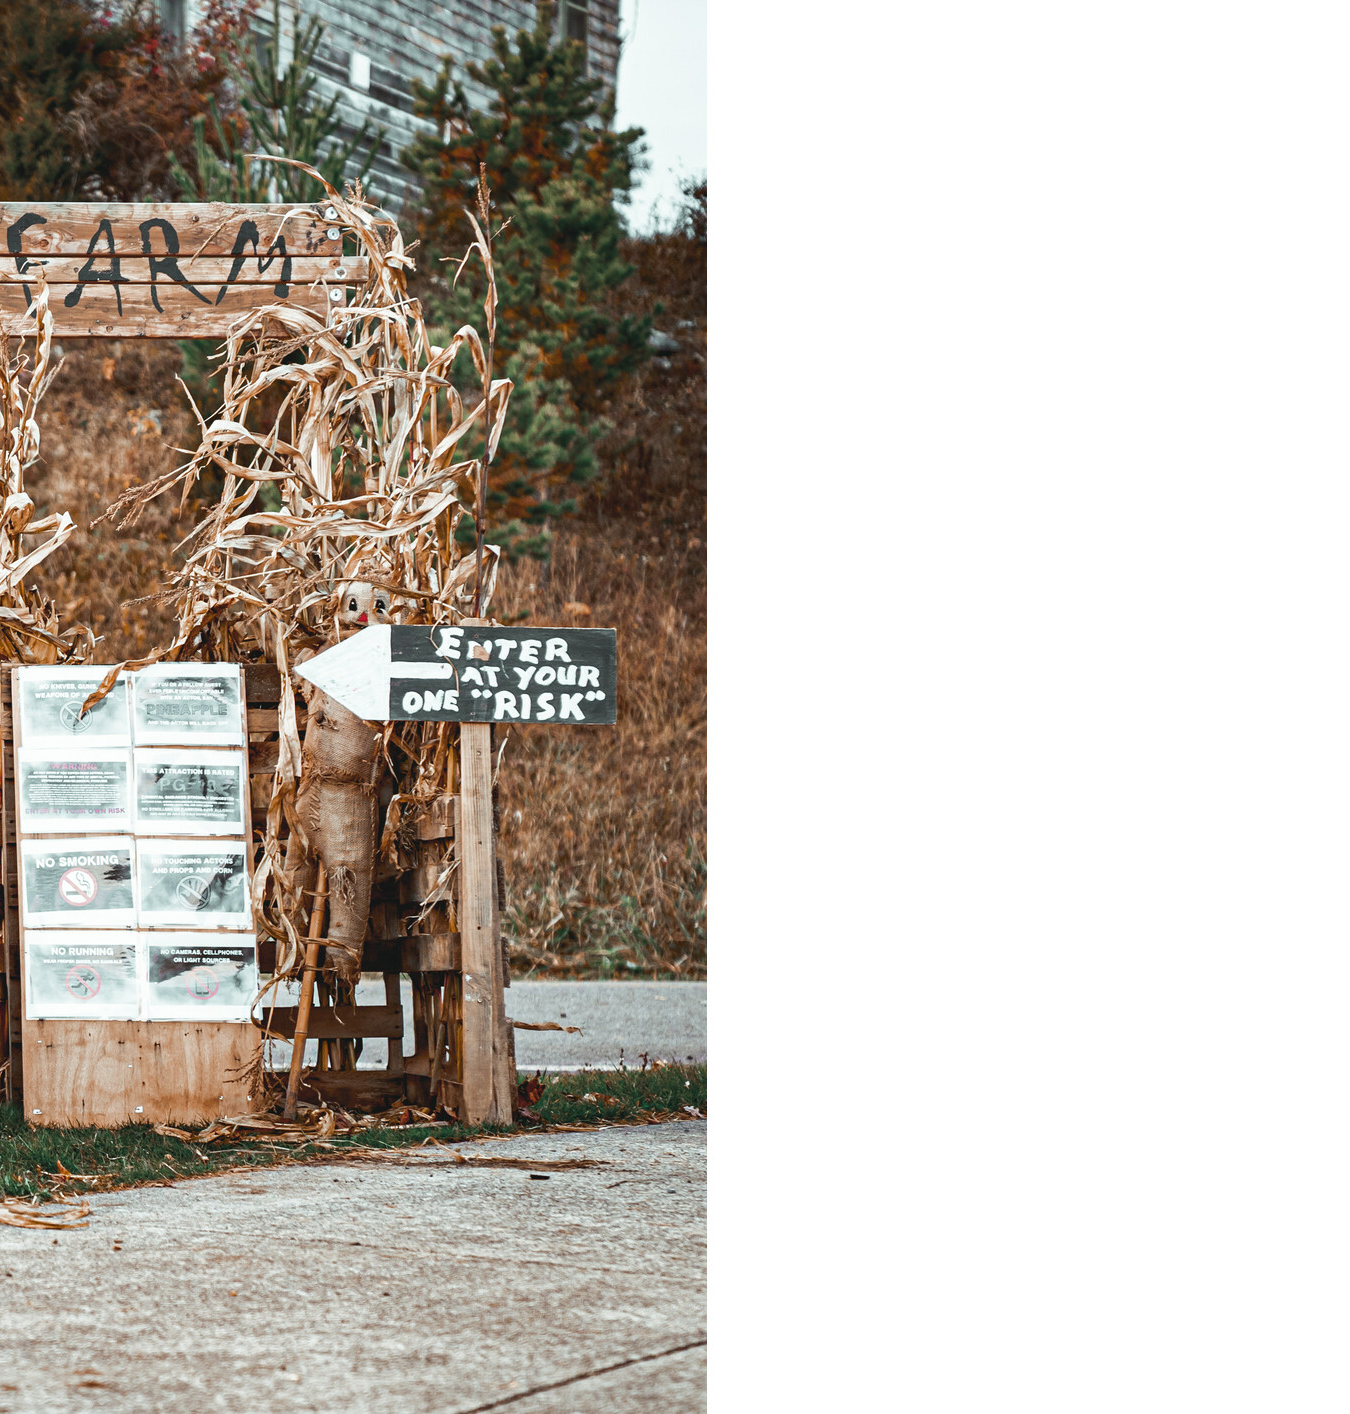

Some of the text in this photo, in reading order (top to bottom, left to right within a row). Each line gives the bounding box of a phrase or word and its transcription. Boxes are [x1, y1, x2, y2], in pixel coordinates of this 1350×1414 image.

[6, 212, 292, 319] FARM
[435, 626, 572, 665] ENTER
[460, 665, 601, 690] AT YOUR
[146, 703, 228, 715] PINEAPPLE
[402, 689, 460, 715] ONE
[51, 763, 98, 771] WARNING
[36, 855, 119, 869] NO SMOKING
[164, 857, 202, 865] TOUCHING
[203, 857, 234, 865] ACTORS
[50, 947, 114, 956] NO RUNNING
